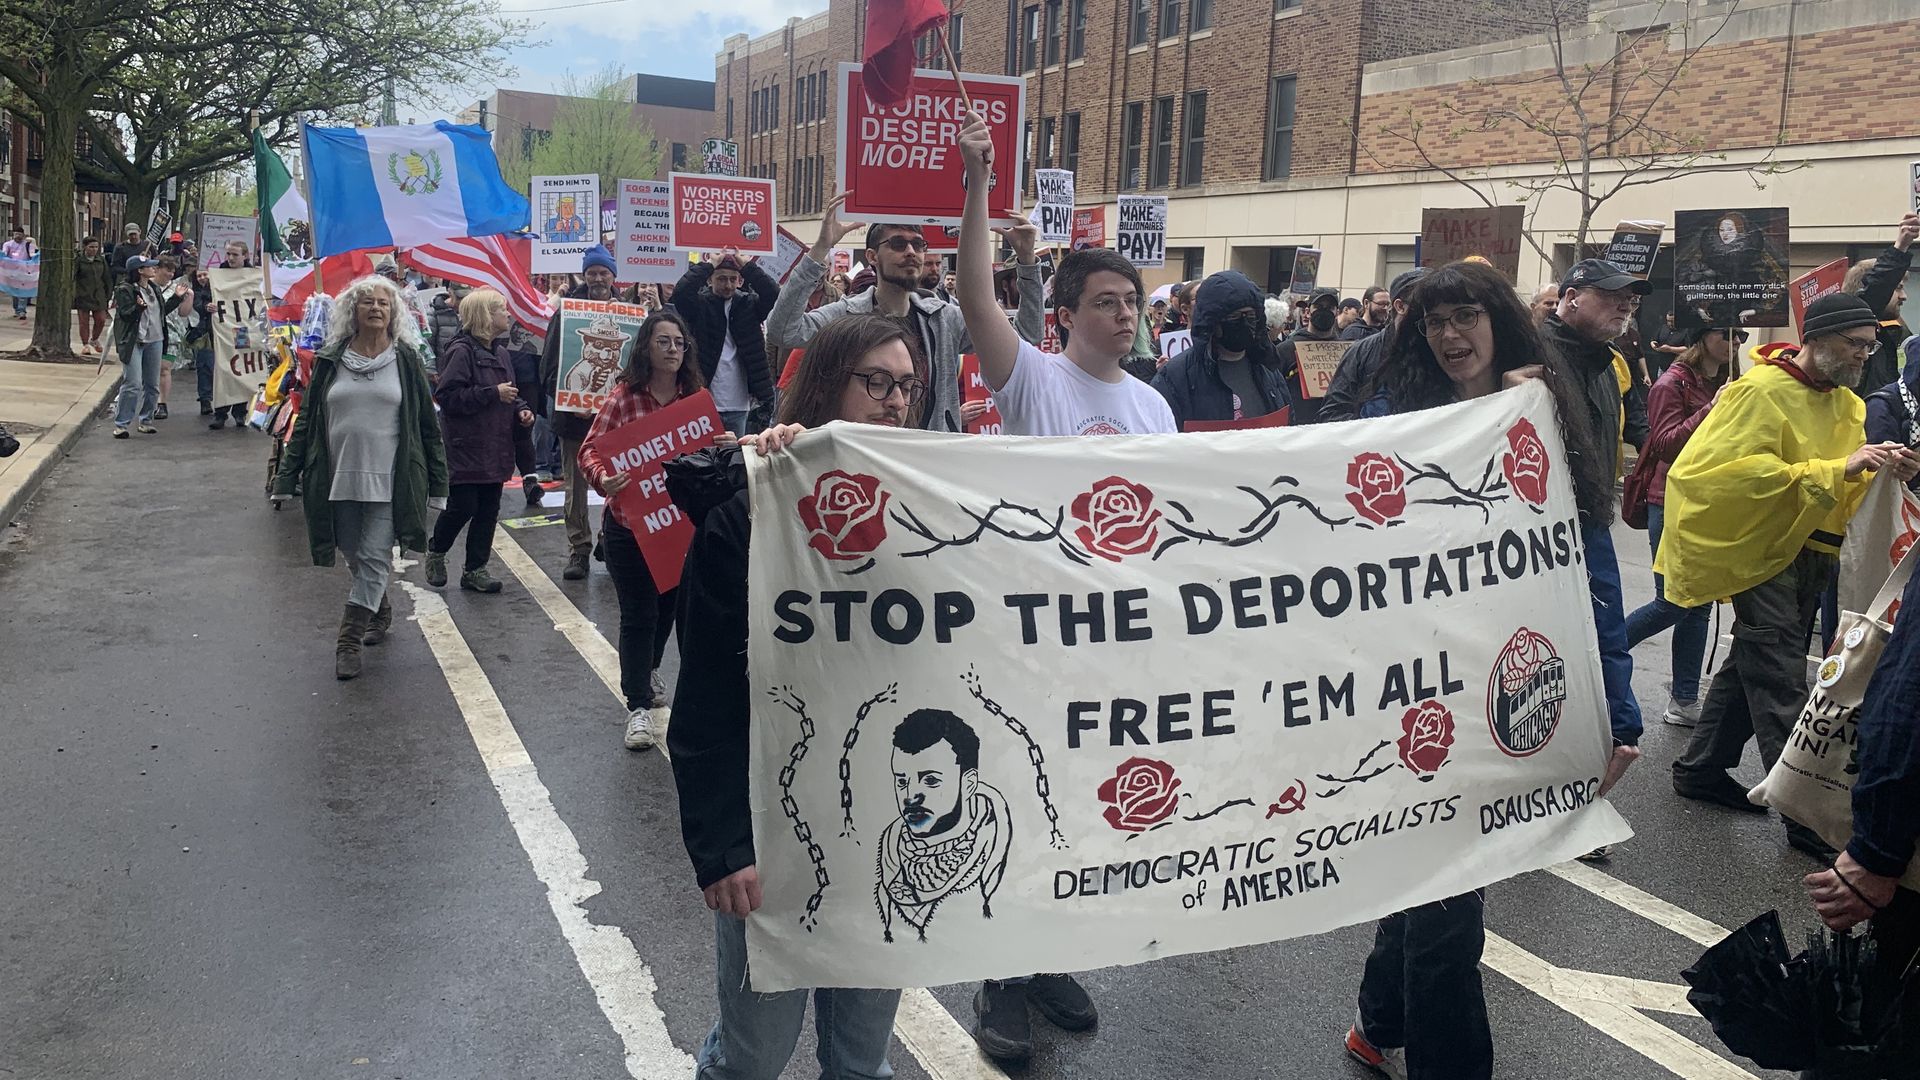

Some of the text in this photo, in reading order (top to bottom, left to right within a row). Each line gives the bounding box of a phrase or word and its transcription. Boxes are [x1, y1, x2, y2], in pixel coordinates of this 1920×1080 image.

[862, 117, 993, 146] DESER
[703, 141, 736, 157] OP THE
[861, 143, 947, 170] MORE
[626, 184, 651, 192] EGGS
[683, 185, 764, 203] WORKERS
[1040, 180, 1066, 195] MAKE
[630, 197, 669, 206] EXPENSI
[682, 198, 757, 215] DESERVE
[634, 210, 669, 218] BECAUS
[683, 211, 732, 226] MORE
[1042, 206, 1072, 234] PAY!
[1120, 206, 1153, 221] MAKE
[1120, 222, 1164, 230] BILLIONAIRES
[1425, 218, 1491, 245] MAKE
[630, 234, 670, 242] CHICKEN
[1118, 233, 1163, 259] PAY!
[552, 247, 586, 255] SALVAD
[1612, 242, 1650, 253] RÉGIMEN
[627, 257, 675, 265] CONGRESS
[1608, 253, 1646, 263] FASCISTA
[1620, 264, 1645, 272] UMP
[1686, 292, 1726, 300] guillotine,
[1800, 284, 1819, 300] STOP
[1802, 282, 1840, 308] DEPORTATIONS
[217, 298, 256, 322] FIX
[563, 301, 645, 317] REMEMBER
[614, 315, 644, 324] PREVENT
[557, 392, 607, 409] FASC
[980, 423, 1000, 435] NO
[1109, 418, 1130, 433] SOCIAL
[611, 415, 714, 473] MONEY FOR
[643, 504, 682, 534] NOT
[773, 518, 1581, 646] STOP THE DEPORTATIONS!
[1067, 650, 1464, 748] FREE 'EM ALL
[1808, 692, 1861, 725] NITE
[1510, 700, 1557, 749] CHICAGO
[1815, 773, 1849, 791] Socialists
[1054, 795, 1461, 899] DEMOCRATIC SOCIALISTS
[1182, 857, 1340, 910] of AMERICA
